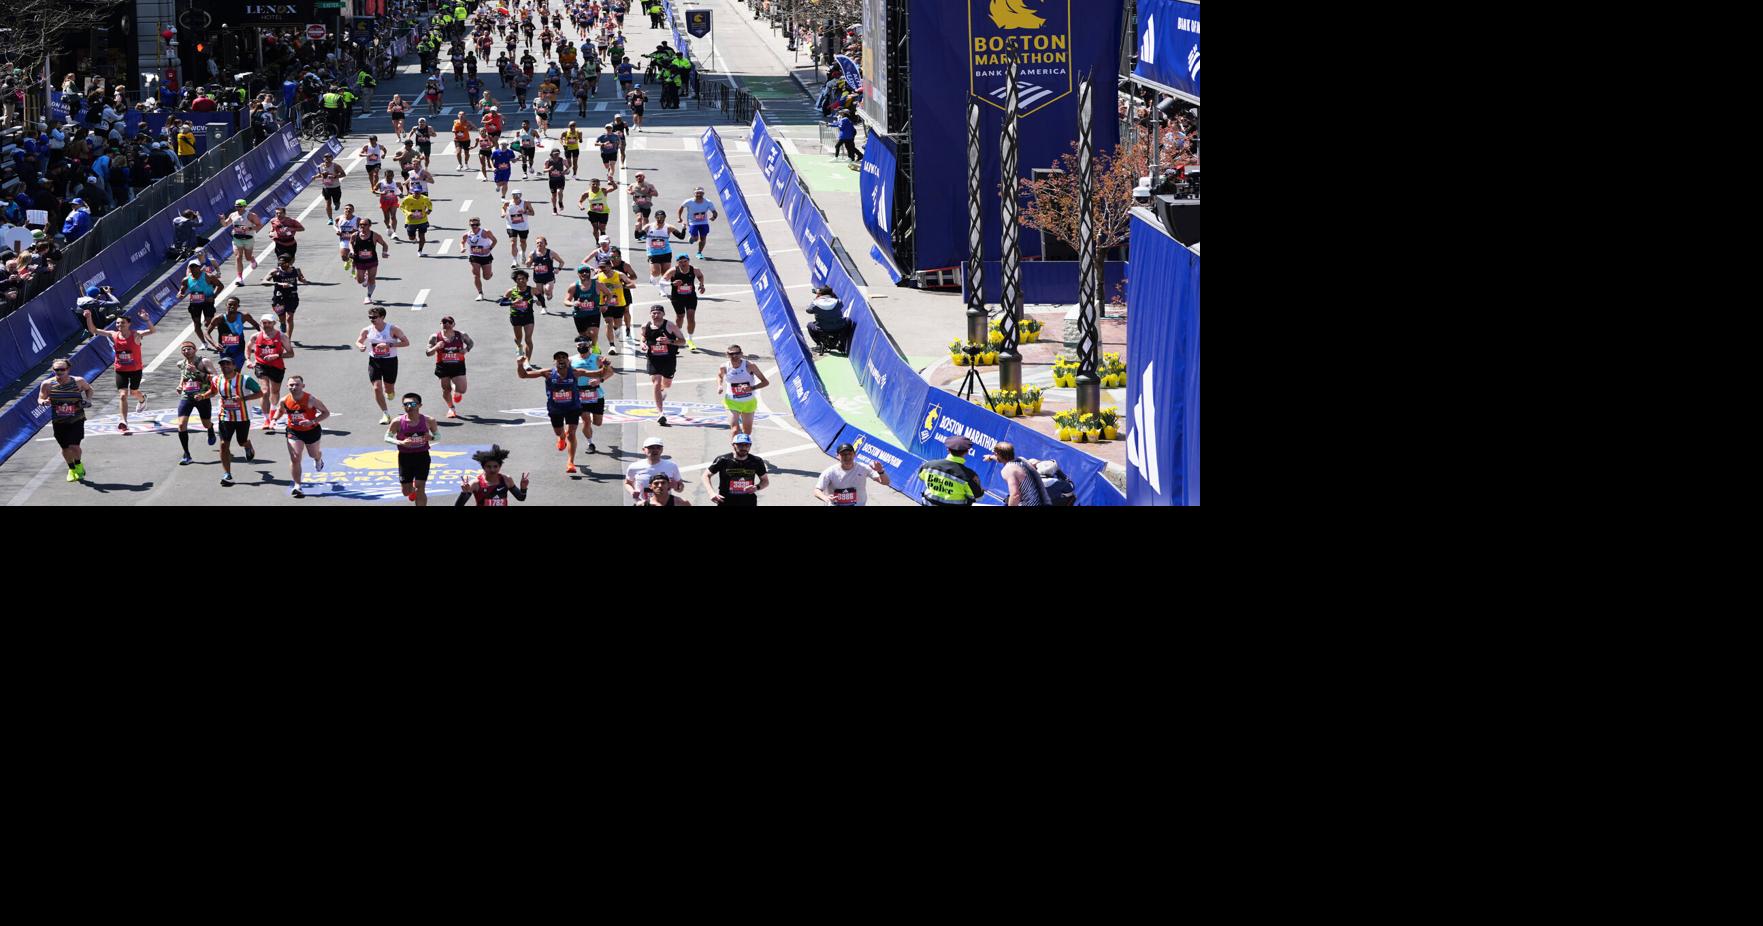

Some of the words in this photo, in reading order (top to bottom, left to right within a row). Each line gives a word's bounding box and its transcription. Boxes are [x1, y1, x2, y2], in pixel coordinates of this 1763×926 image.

[246, 4, 297, 14] LENOX
[974, 34, 1065, 52] BOSTON
[1020, 68, 1066, 76] AMERICA
[939, 415, 964, 435] BOSTON
[927, 473, 954, 487] Boston
[927, 482, 954, 495] Police
